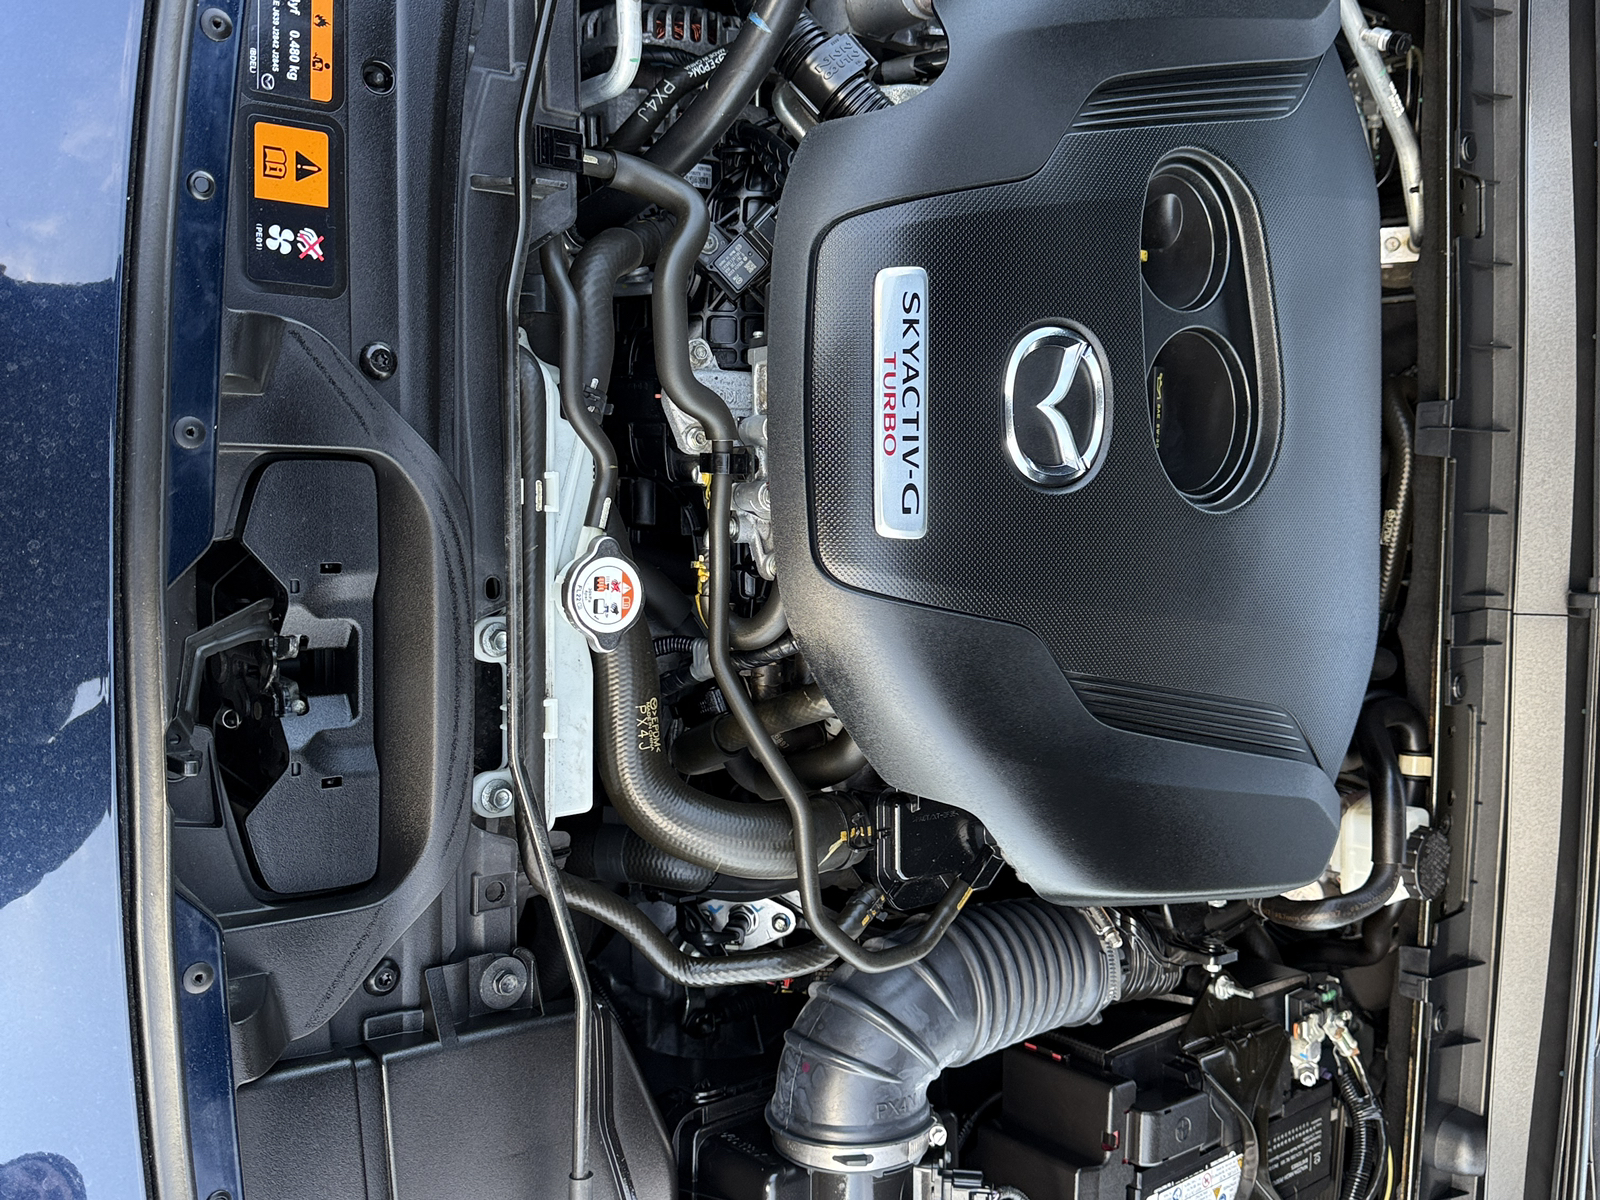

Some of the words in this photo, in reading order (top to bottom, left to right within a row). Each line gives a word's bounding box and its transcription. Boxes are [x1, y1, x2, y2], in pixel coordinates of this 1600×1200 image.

[272, 7, 280, 26] J639
[272, 26, 280, 49] J2842
[289, 30, 300, 63] 0.480
[272, 49, 280, 72] J2845
[286, 65, 300, 81] kg
[637, 78, 676, 123] PX4J
[255, 223, 263, 251] (PE01)
[883, 352, 897, 456] TURBO
[902, 291, 921, 515] SKYACTIV-G
[635, 704, 651, 750] PX4J
